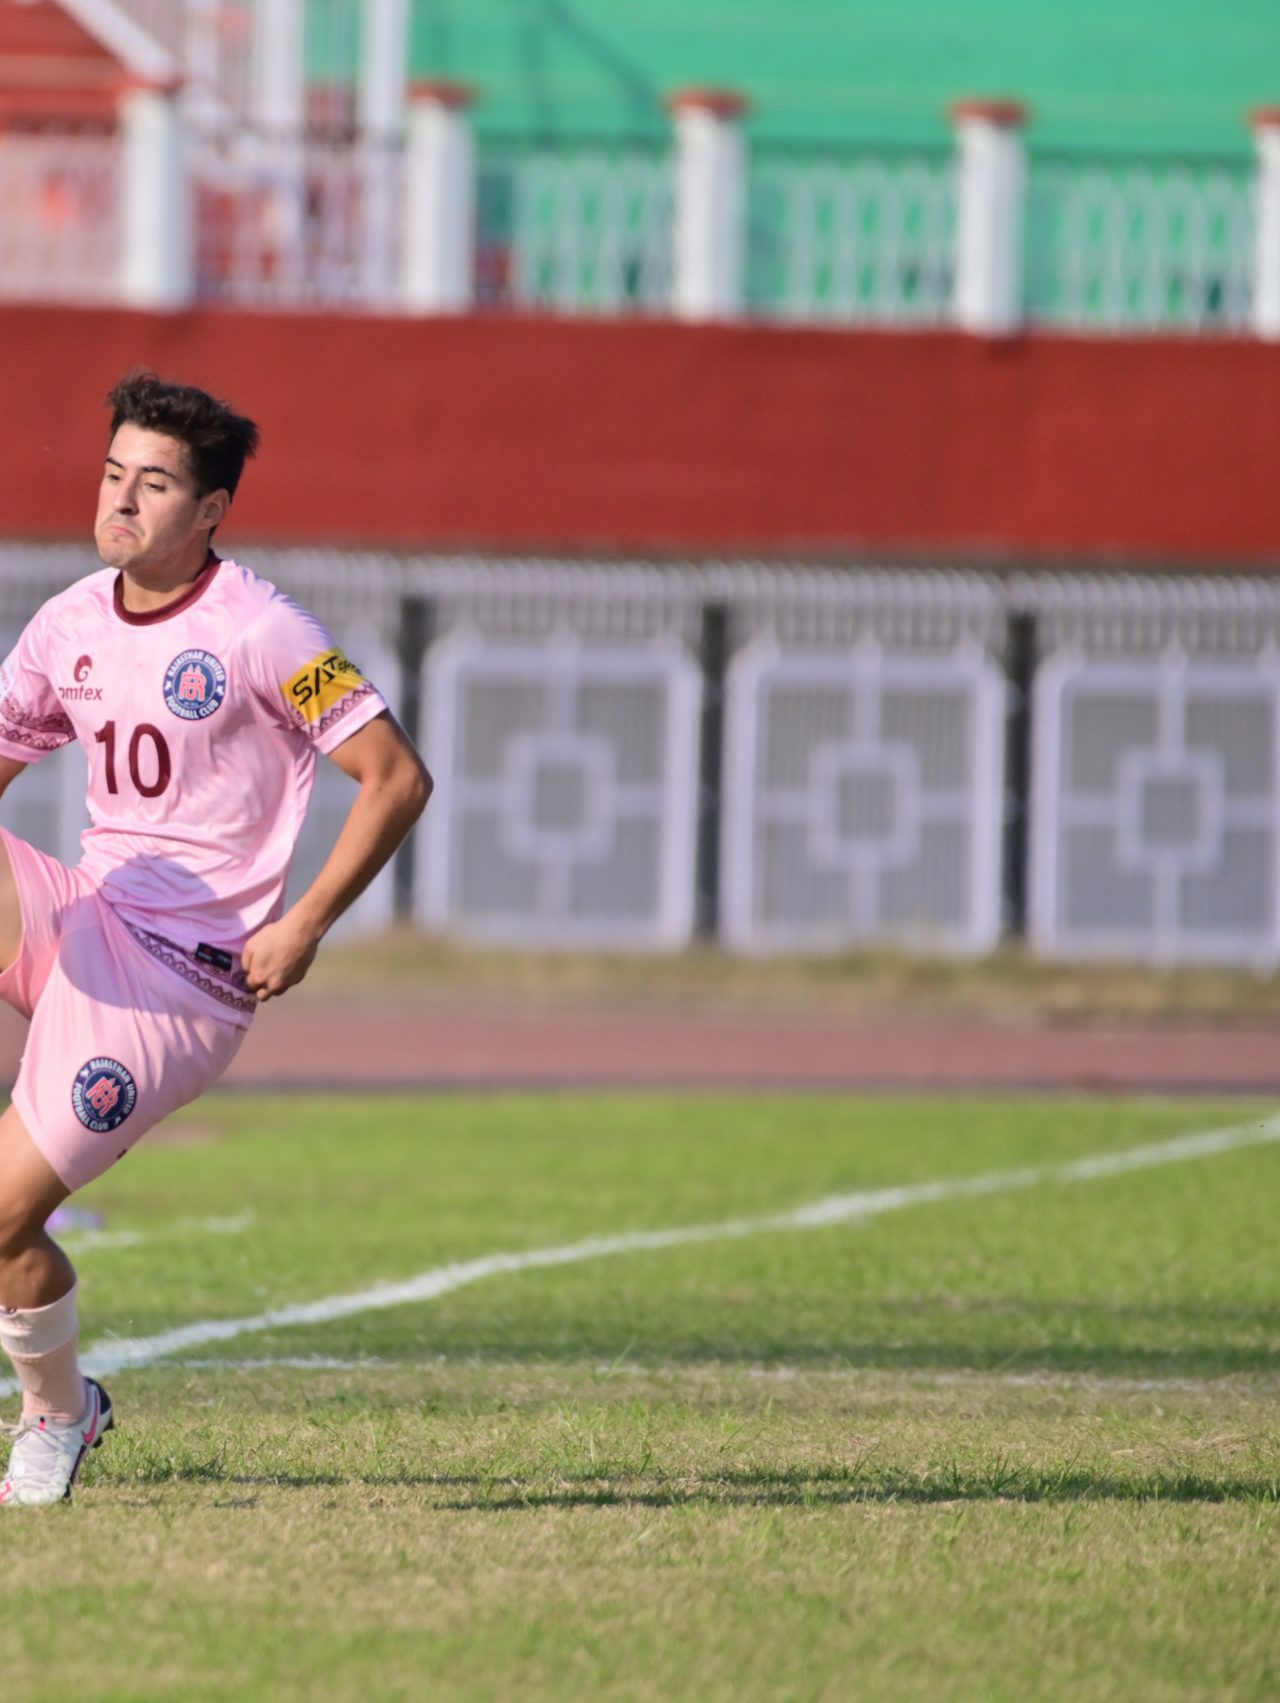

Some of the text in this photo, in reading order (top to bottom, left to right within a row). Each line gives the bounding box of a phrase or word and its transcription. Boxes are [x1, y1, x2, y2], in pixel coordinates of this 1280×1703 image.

[168, 651, 225, 682] RAJASTHAN UNITED
[166, 695, 219, 719] FOOTBALL CLUB
[94, 720, 171, 798] 10
[89, 1058, 131, 1083] RAJASTHAN
[73, 1082, 91, 1126] FOOTBALL
[89, 1120, 109, 1131] CLUB
